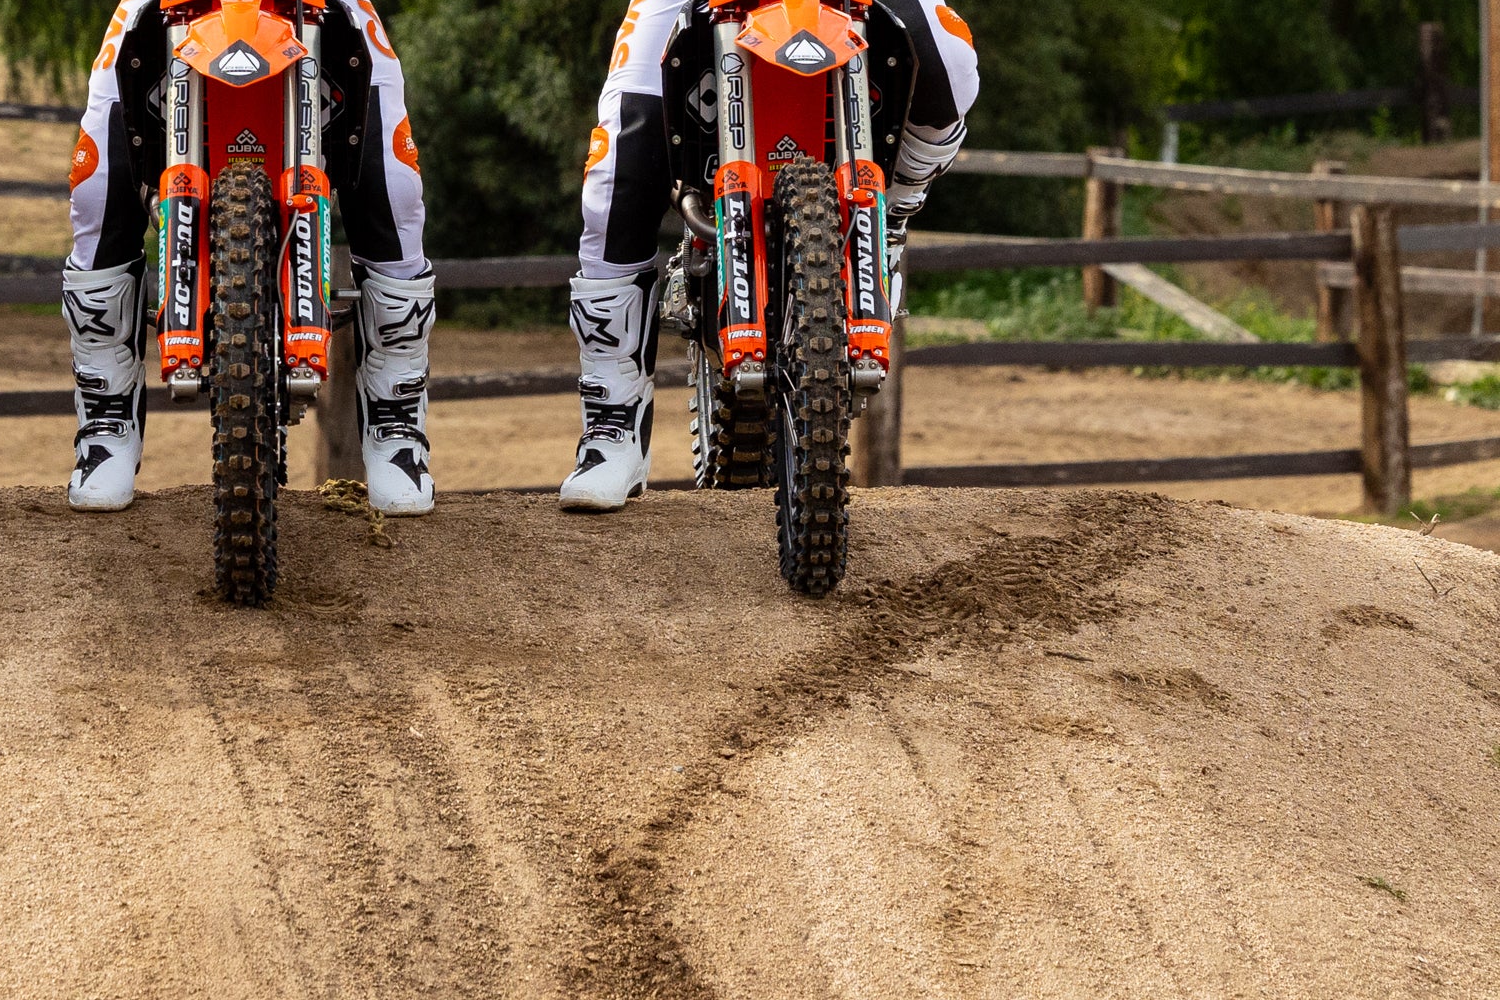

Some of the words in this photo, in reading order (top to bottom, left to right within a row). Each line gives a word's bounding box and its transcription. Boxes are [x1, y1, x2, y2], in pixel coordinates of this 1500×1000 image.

[174, 80, 189, 155] REP
[728, 76, 744, 150] REP
[228, 145, 265, 153] DUBYA
[768, 152, 805, 160] DUBYA
[323, 206, 332, 283] MOTOREX
[727, 329, 763, 339] TAMER
[849, 326, 885, 335] TAMER
[165, 337, 200, 346] TAMER
[287, 332, 323, 342] TAMER
